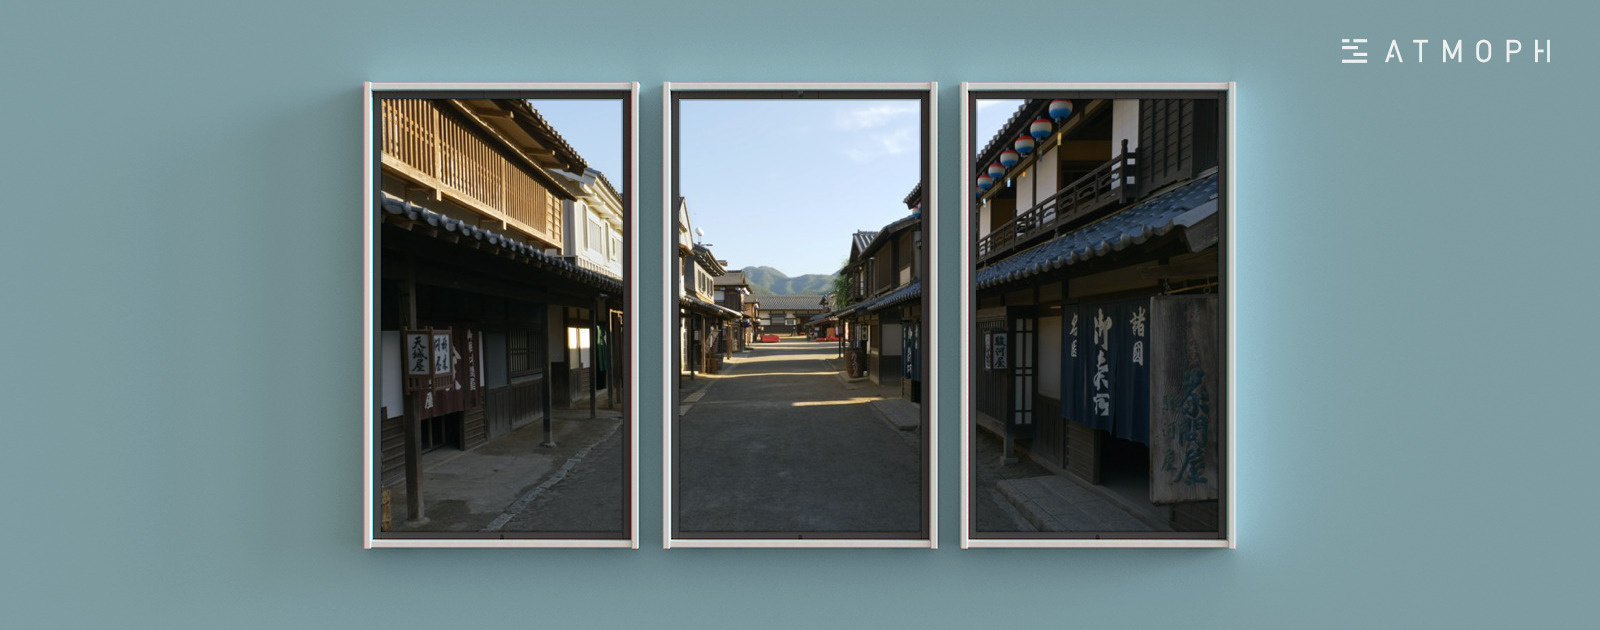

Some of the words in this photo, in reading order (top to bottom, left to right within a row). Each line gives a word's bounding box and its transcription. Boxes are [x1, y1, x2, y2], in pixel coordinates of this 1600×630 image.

[412, 336, 427, 372] 天城屋
[994, 335, 1007, 368] 駿河屋
